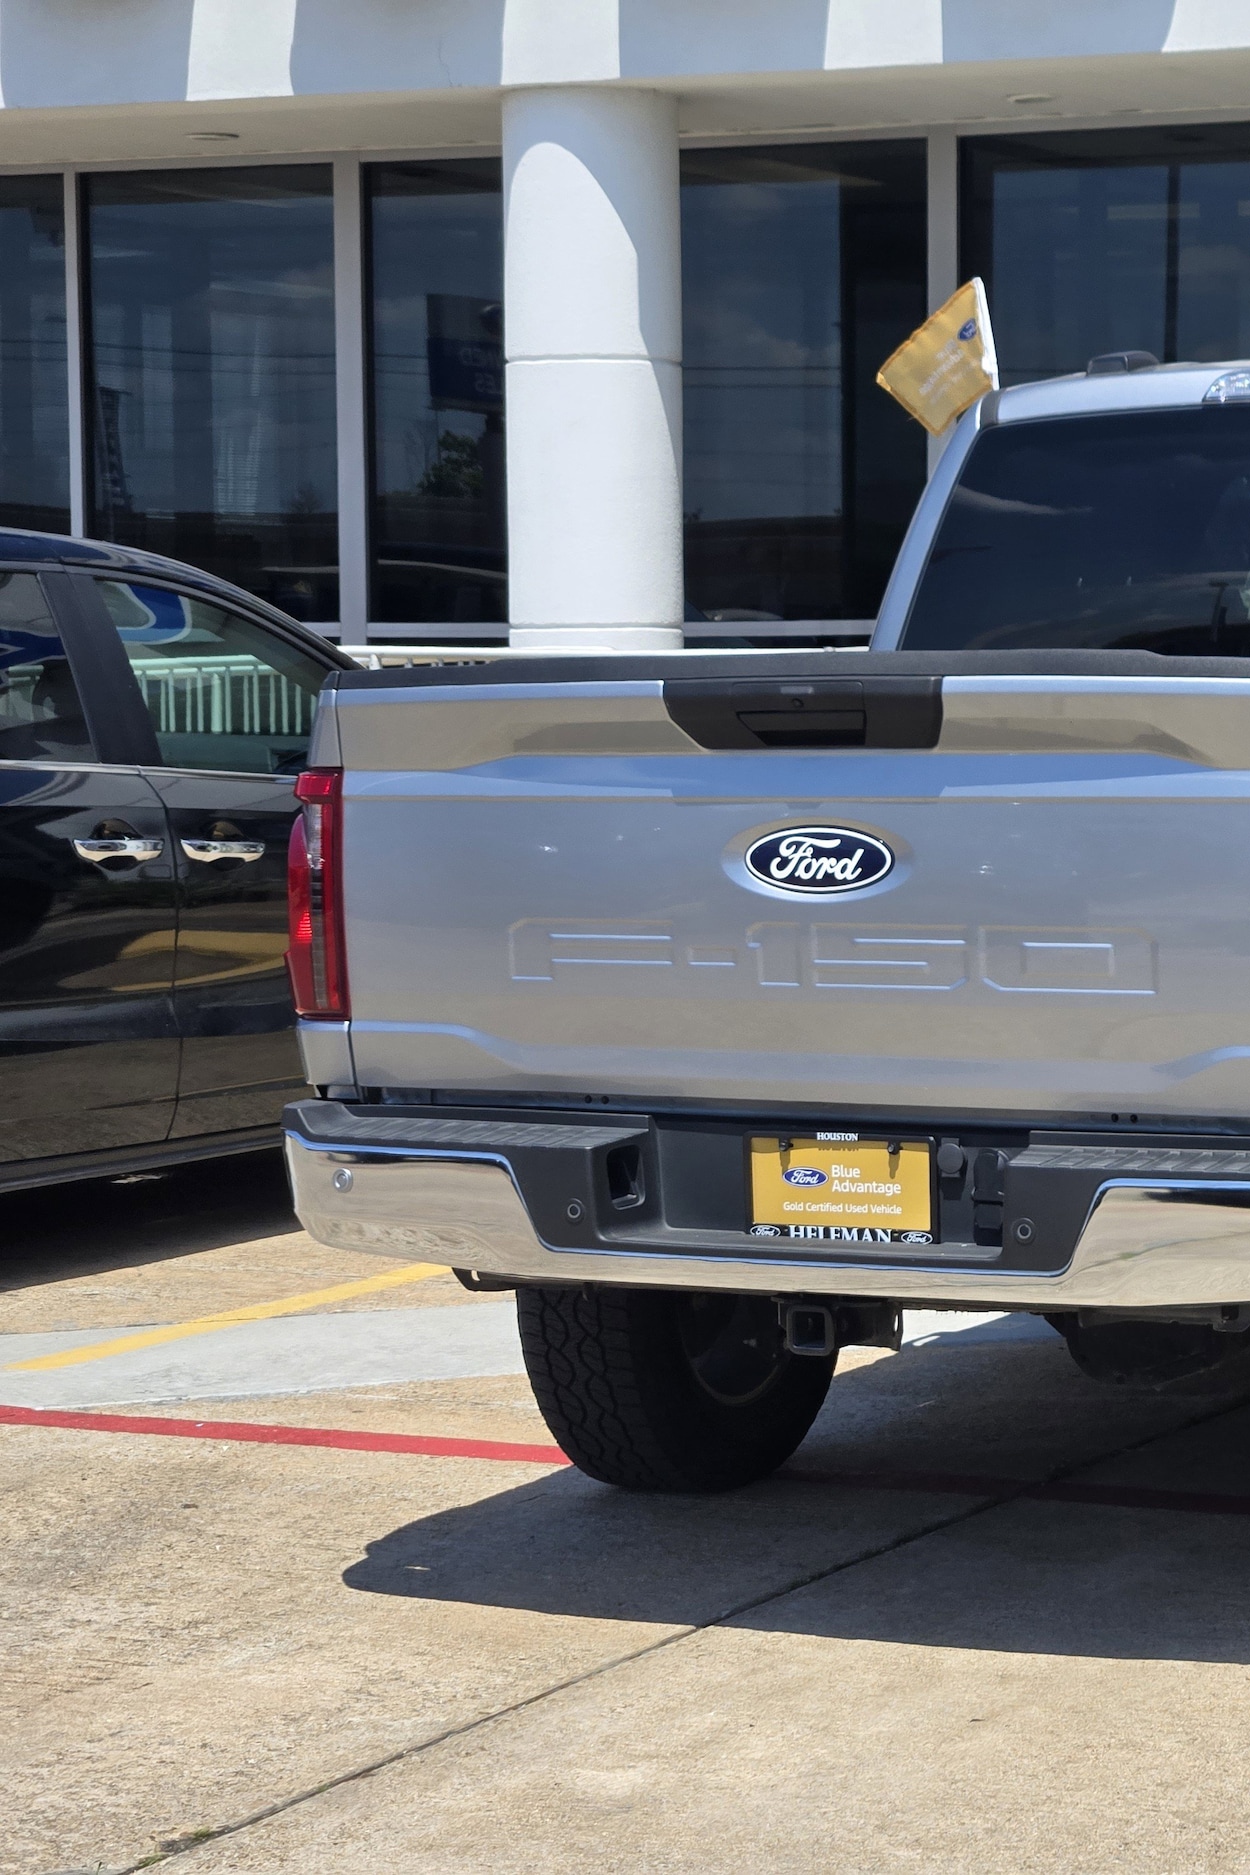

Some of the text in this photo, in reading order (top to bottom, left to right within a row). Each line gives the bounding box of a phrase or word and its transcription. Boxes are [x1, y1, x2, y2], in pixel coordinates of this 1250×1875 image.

[770, 836, 865, 880] Ford
[508, 916, 1158, 996] F-150
[816, 1132, 859, 1142] HOUSTON
[790, 1169, 820, 1185] Ford
[831, 1164, 861, 1178] Blue
[831, 1180, 902, 1196] Advantage
[783, 1201, 902, 1215] Gold Certified Used Vehicle
